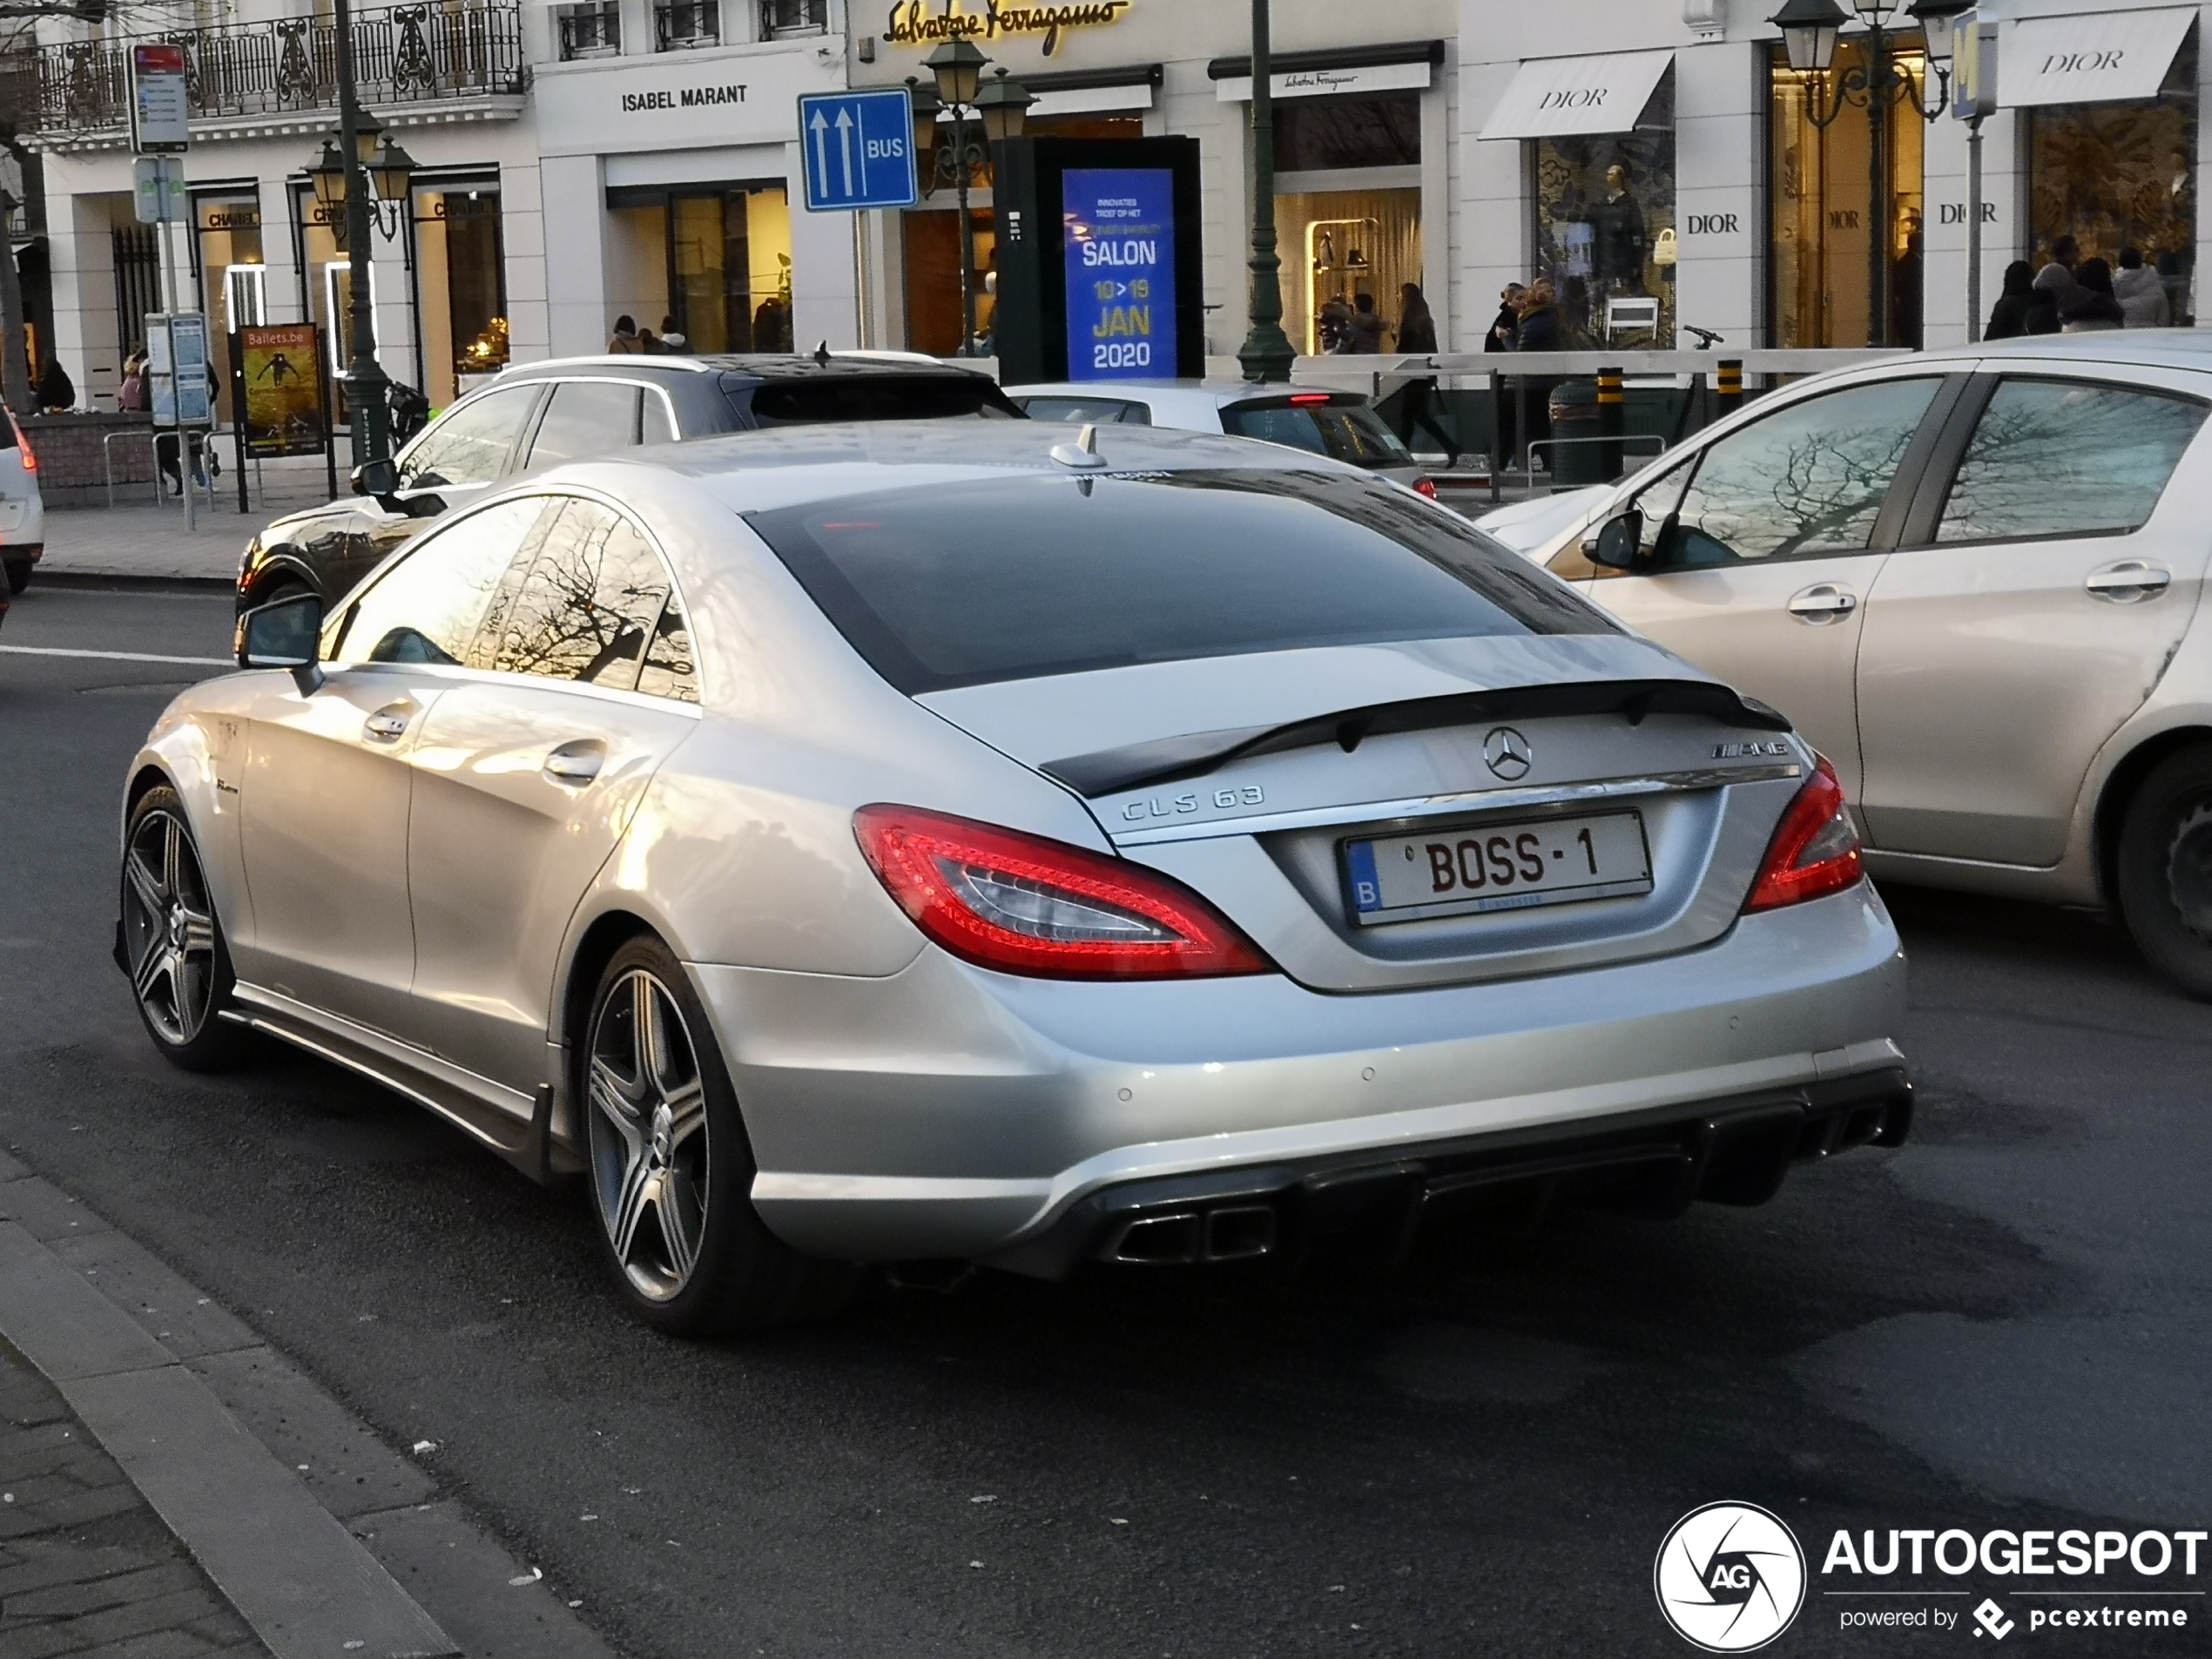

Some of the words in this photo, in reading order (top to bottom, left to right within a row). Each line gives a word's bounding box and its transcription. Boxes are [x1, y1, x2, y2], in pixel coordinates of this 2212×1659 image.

[883, 0, 985, 43] Salvatore
[986, 0, 1129, 56] Ferragamo
[1953, 22, 1978, 105] M
[2040, 50, 2125, 75] DIOR
[1316, 72, 1358, 91] Ferragamo
[622, 91, 677, 112] ISABEL
[680, 85, 747, 106] MARANT
[1539, 88, 1608, 110] DIOR
[867, 138, 903, 158] BUS
[1687, 213, 1740, 235] DIOR
[1940, 203, 1998, 224] DIR
[1082, 240, 1156, 266] SALON
[1093, 306, 1150, 338] JAN
[248, 333, 305, 345] Ballets.be
[1094, 342, 1151, 368] 2020
[1122, 793, 1198, 821] CLS
[1212, 785, 1265, 808] 63
[1357, 881, 1377, 905] B
